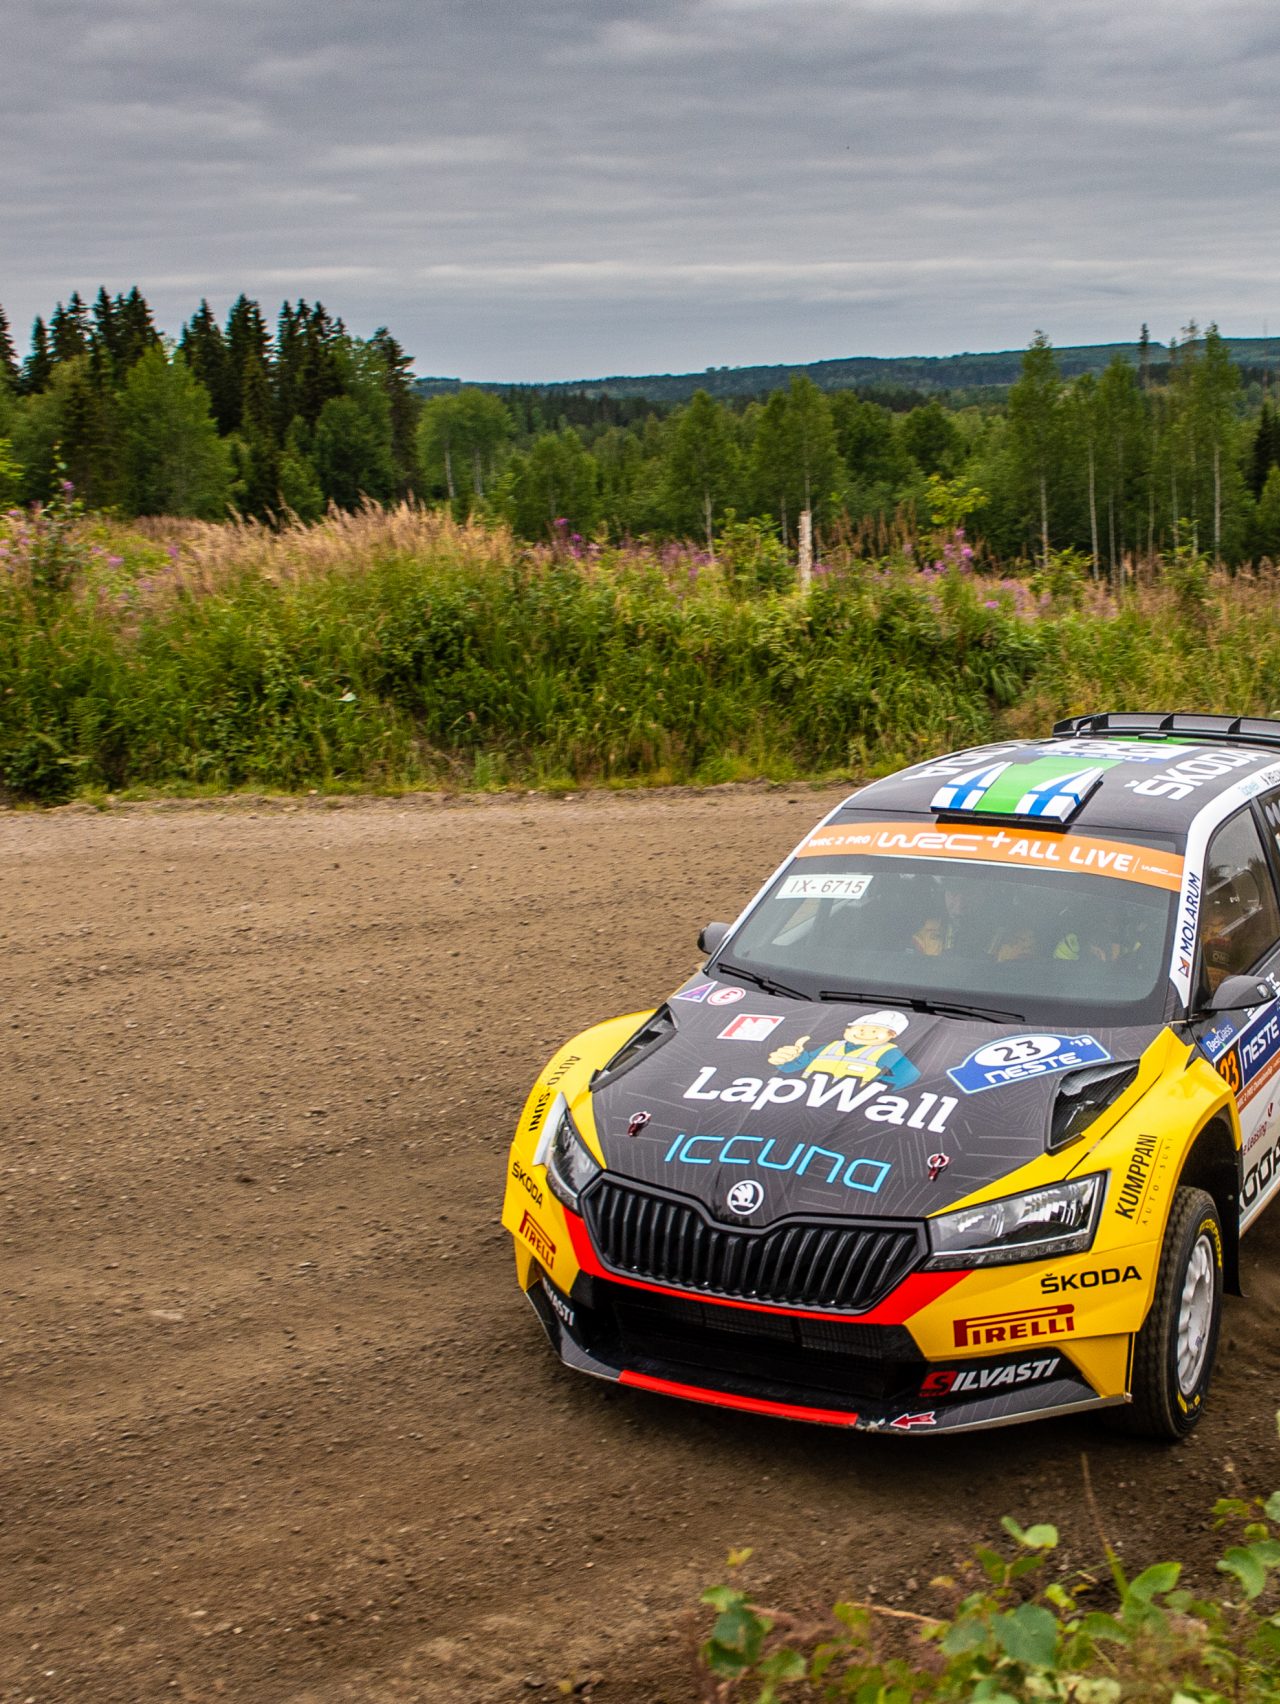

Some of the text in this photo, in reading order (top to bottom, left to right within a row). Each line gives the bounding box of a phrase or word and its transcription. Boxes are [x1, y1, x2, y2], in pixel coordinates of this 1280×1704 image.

[1124, 750, 1271, 801] ŠKODA
[845, 835, 870, 845] PRO
[1008, 838, 1060, 861] ALL
[1069, 848, 1134, 872] LIVE
[821, 880, 865, 894] 6715
[1180, 872, 1200, 956] MOLARUM
[994, 1040, 1041, 1062] 23
[1242, 1016, 1279, 1069] NESTE
[984, 1052, 1082, 1084] NESTE
[1220, 1050, 1239, 1093] 23
[683, 1066, 959, 1133] LapWall
[511, 1161, 543, 1208] ŠKODA
[1115, 1134, 1157, 1220] KUMPPANI
[519, 1209, 556, 1270] PIRELLI
[1040, 1266, 1142, 1294] ŠKODA
[953, 1304, 1075, 1347] PIRELLI
[920, 1357, 1061, 1394] SILVASTI
